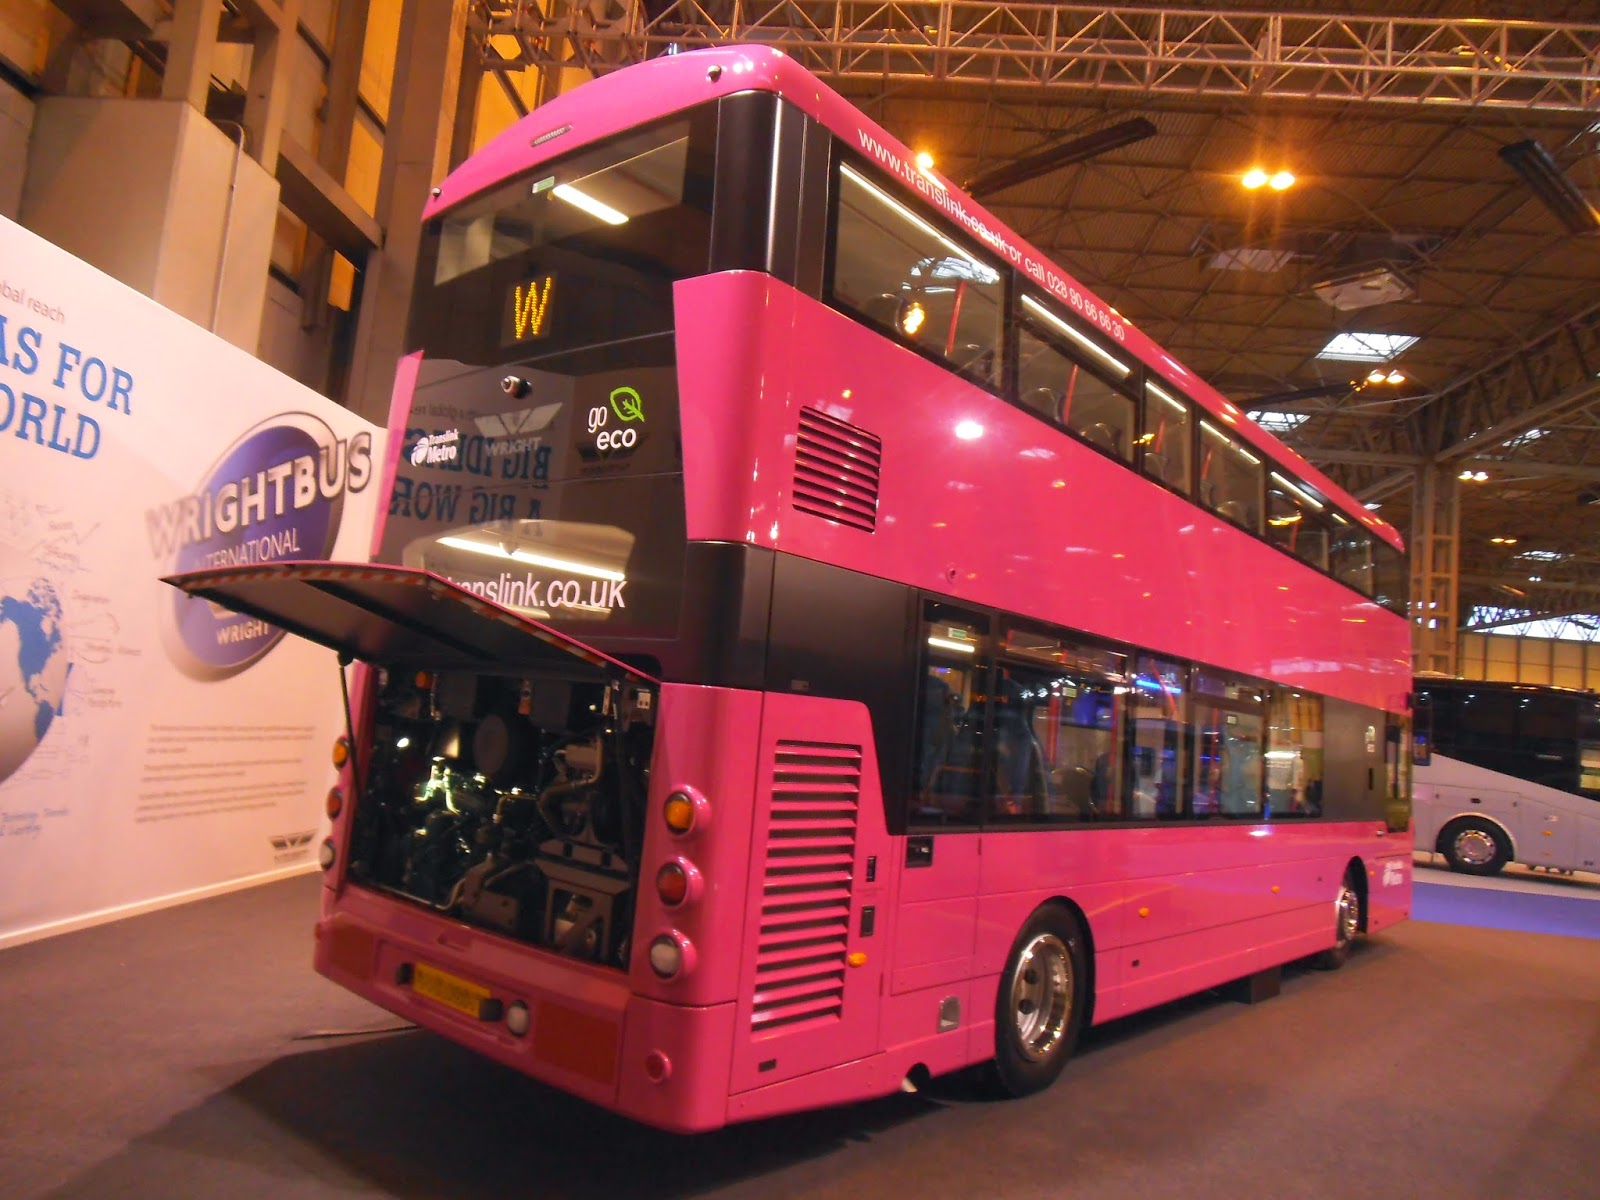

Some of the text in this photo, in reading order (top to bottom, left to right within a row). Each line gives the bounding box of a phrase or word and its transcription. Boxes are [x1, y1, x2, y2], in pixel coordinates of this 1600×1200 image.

[0, 279, 66, 324] bal reach
[515, 277, 552, 340] W
[1009, 245, 1022, 264] or
[1025, 258, 1045, 282] call
[1047, 271, 1068, 298] 028
[1069, 288, 1083, 310] 90
[1084, 300, 1098, 321] 66
[1099, 310, 1112, 331] 66
[1112, 320, 1125, 341] 30
[52, 342, 133, 416] FOR
[588, 406, 608, 433] go
[596, 428, 637, 451] eco
[426, 444, 457, 464] Metro
[144, 432, 372, 559] WRIGHTBUS
[216, 619, 270, 645] WRIGHT
